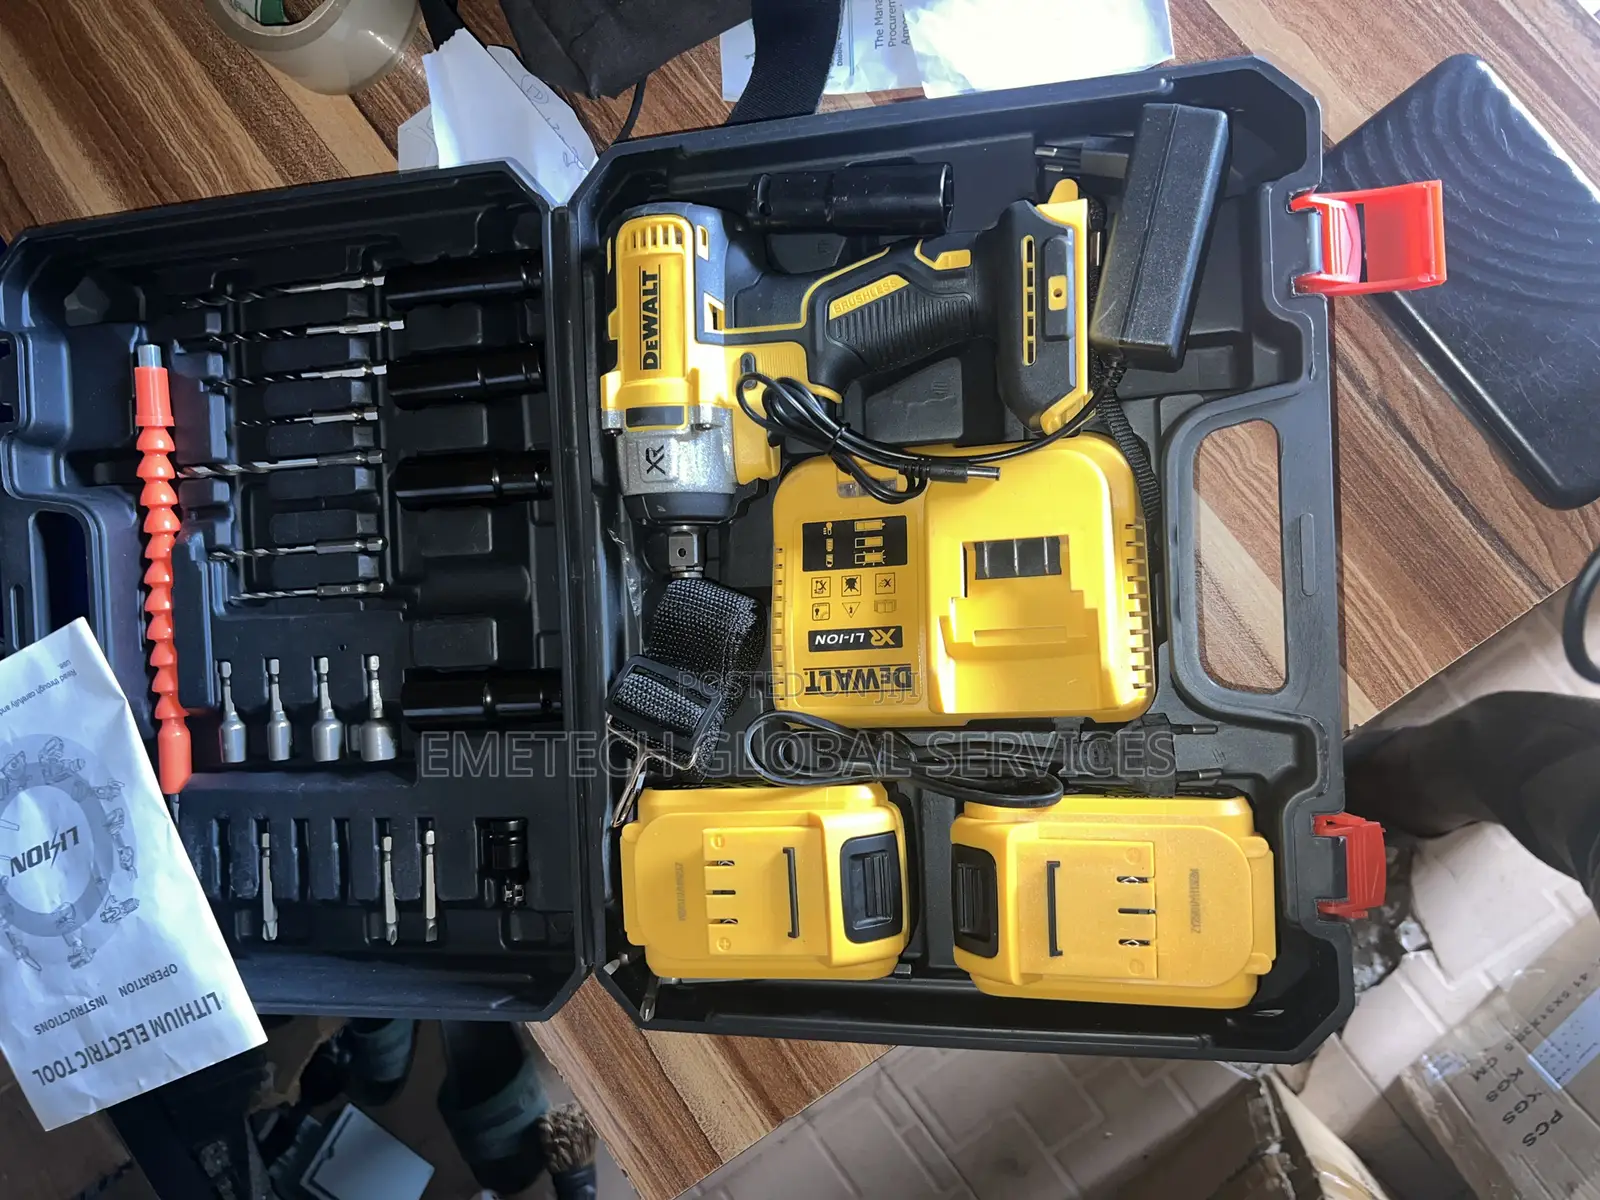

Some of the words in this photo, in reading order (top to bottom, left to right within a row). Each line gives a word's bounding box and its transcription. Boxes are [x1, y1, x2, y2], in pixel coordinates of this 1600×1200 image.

[874, 28, 884, 50] The
[833, 280, 898, 314] BRUSHLESS
[641, 270, 659, 371] DEWALT
[814, 633, 865, 646] LI-ION
[868, 628, 896, 646] XR
[36, 678, 60, 695] through
[60, 668, 78, 683] Read
[805, 666, 913, 692] DEWALT
[10, 691, 36, 709] carefully
[118, 963, 179, 998] OPERATION
[33, 994, 108, 1036] INSTRUCTIONS
[148, 991, 223, 1038] LITHIUM
[75, 1023, 151, 1070] ELECTRIC
[32, 1055, 78, 1087] TOOL
[1485, 1067, 1524, 1102] KGS
[1522, 1109, 1564, 1147] PCS
